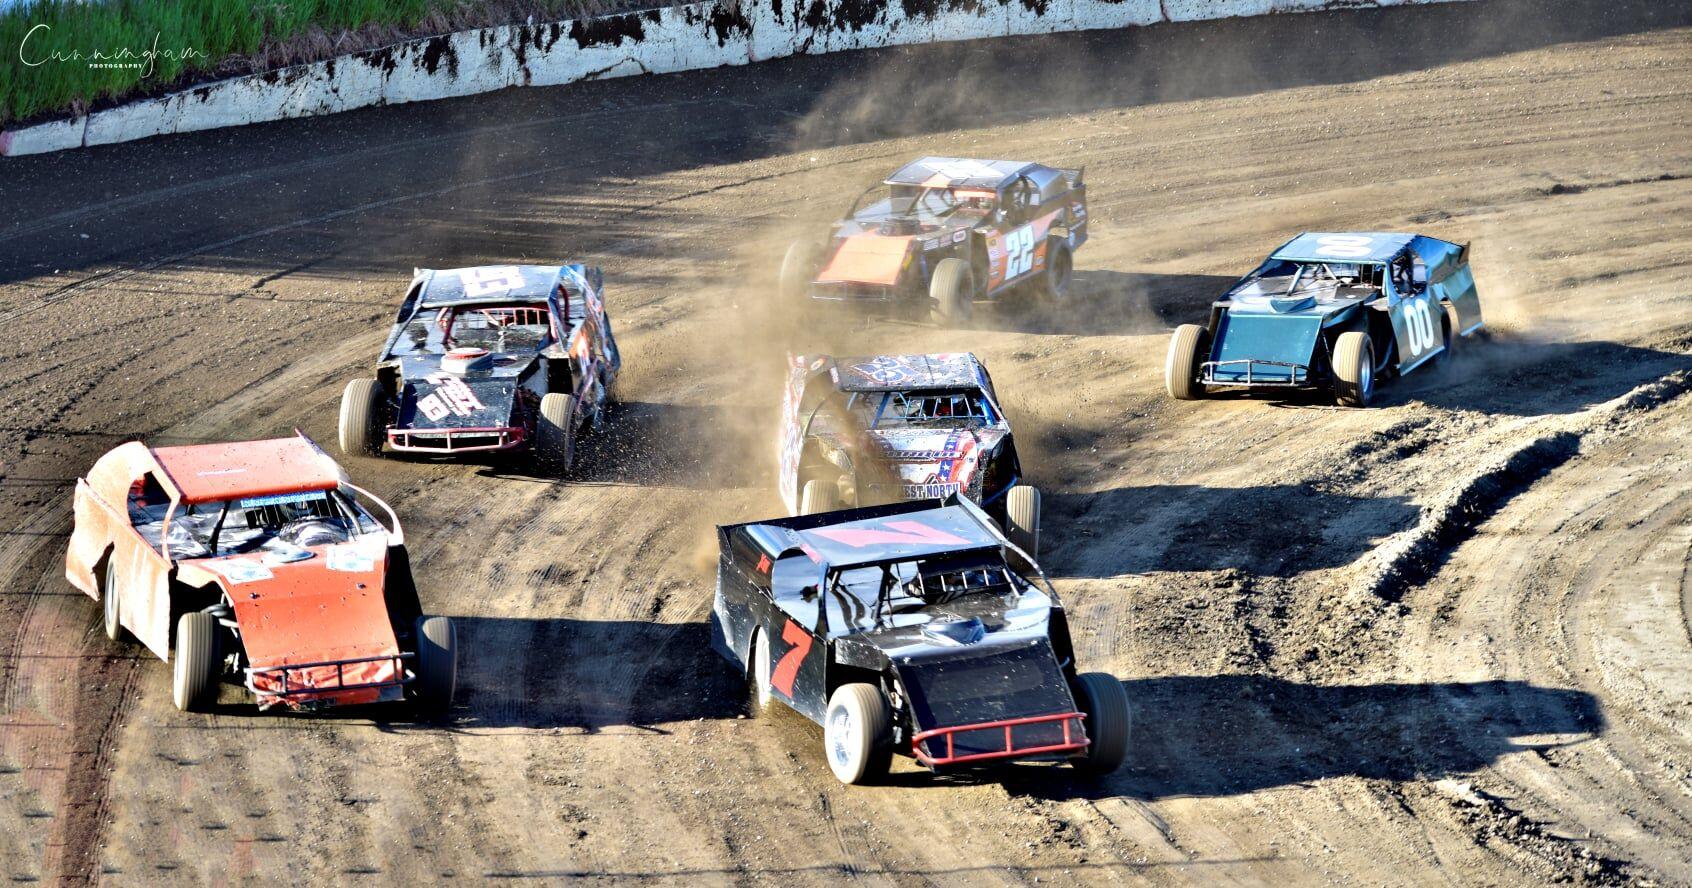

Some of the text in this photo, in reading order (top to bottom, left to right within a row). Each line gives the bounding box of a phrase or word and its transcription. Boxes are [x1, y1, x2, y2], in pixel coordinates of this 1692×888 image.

[1005, 225, 1034, 280] 22
[1316, 235, 1374, 257] 00
[1404, 299, 1434, 357] 00
[770, 618, 814, 699] 7
